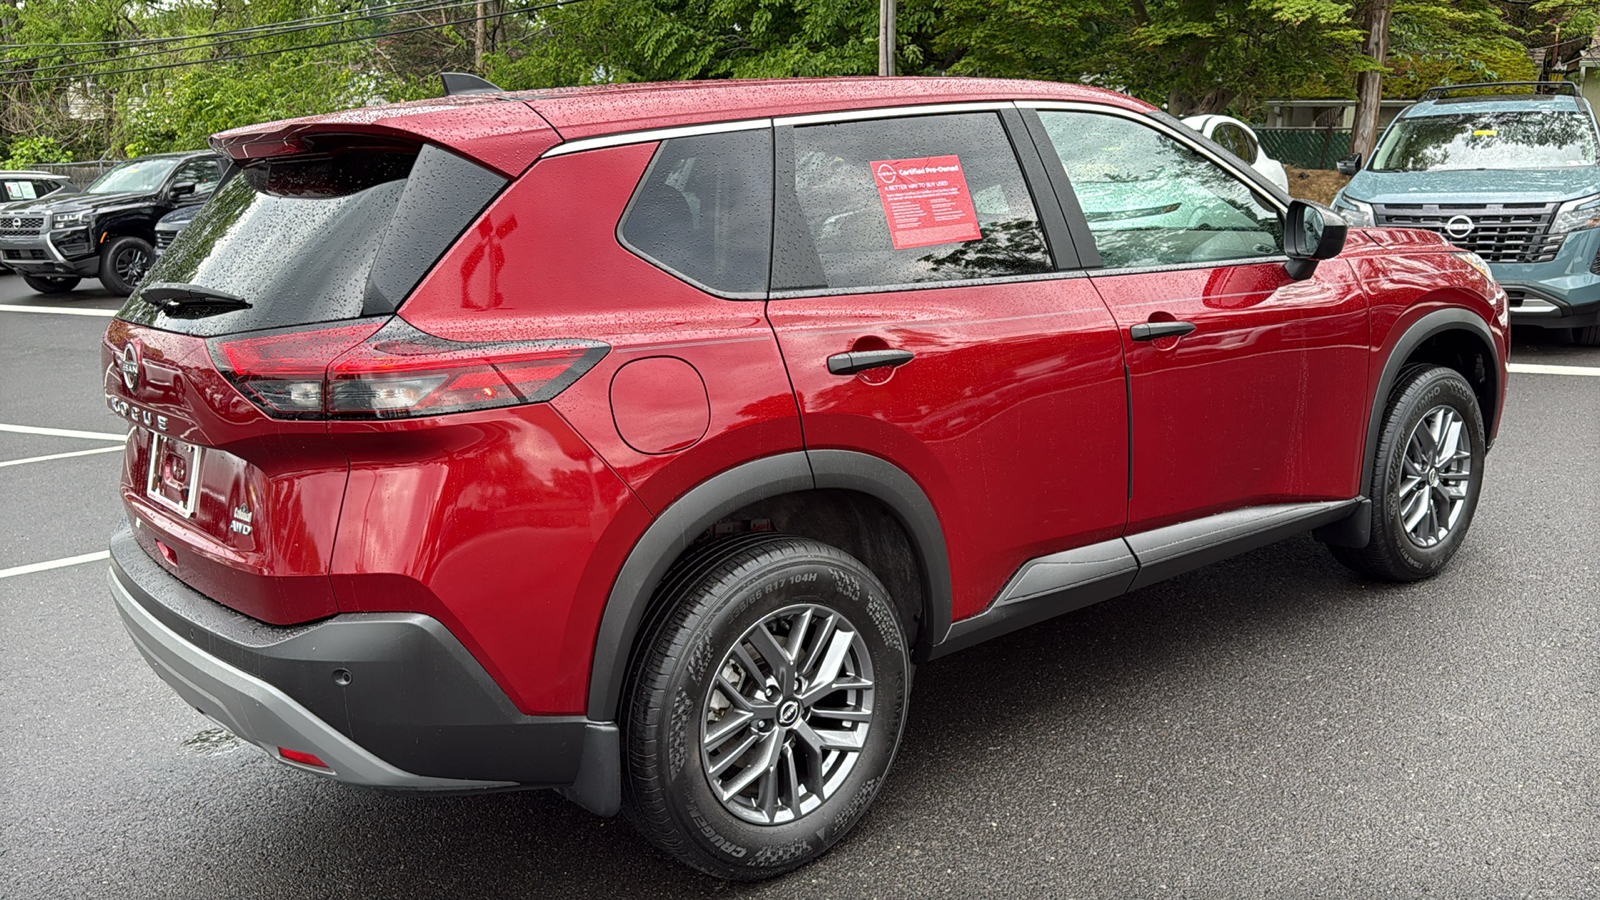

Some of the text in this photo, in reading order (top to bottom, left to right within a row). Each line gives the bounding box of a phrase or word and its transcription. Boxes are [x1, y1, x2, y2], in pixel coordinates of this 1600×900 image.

[898, 164, 959, 176] Certified Pre-Owned
[230, 520, 252, 535] AWD
[765, 580, 786, 594] R17
[789, 573, 818, 585] 104H
[687, 803, 747, 858] CRUGEN
